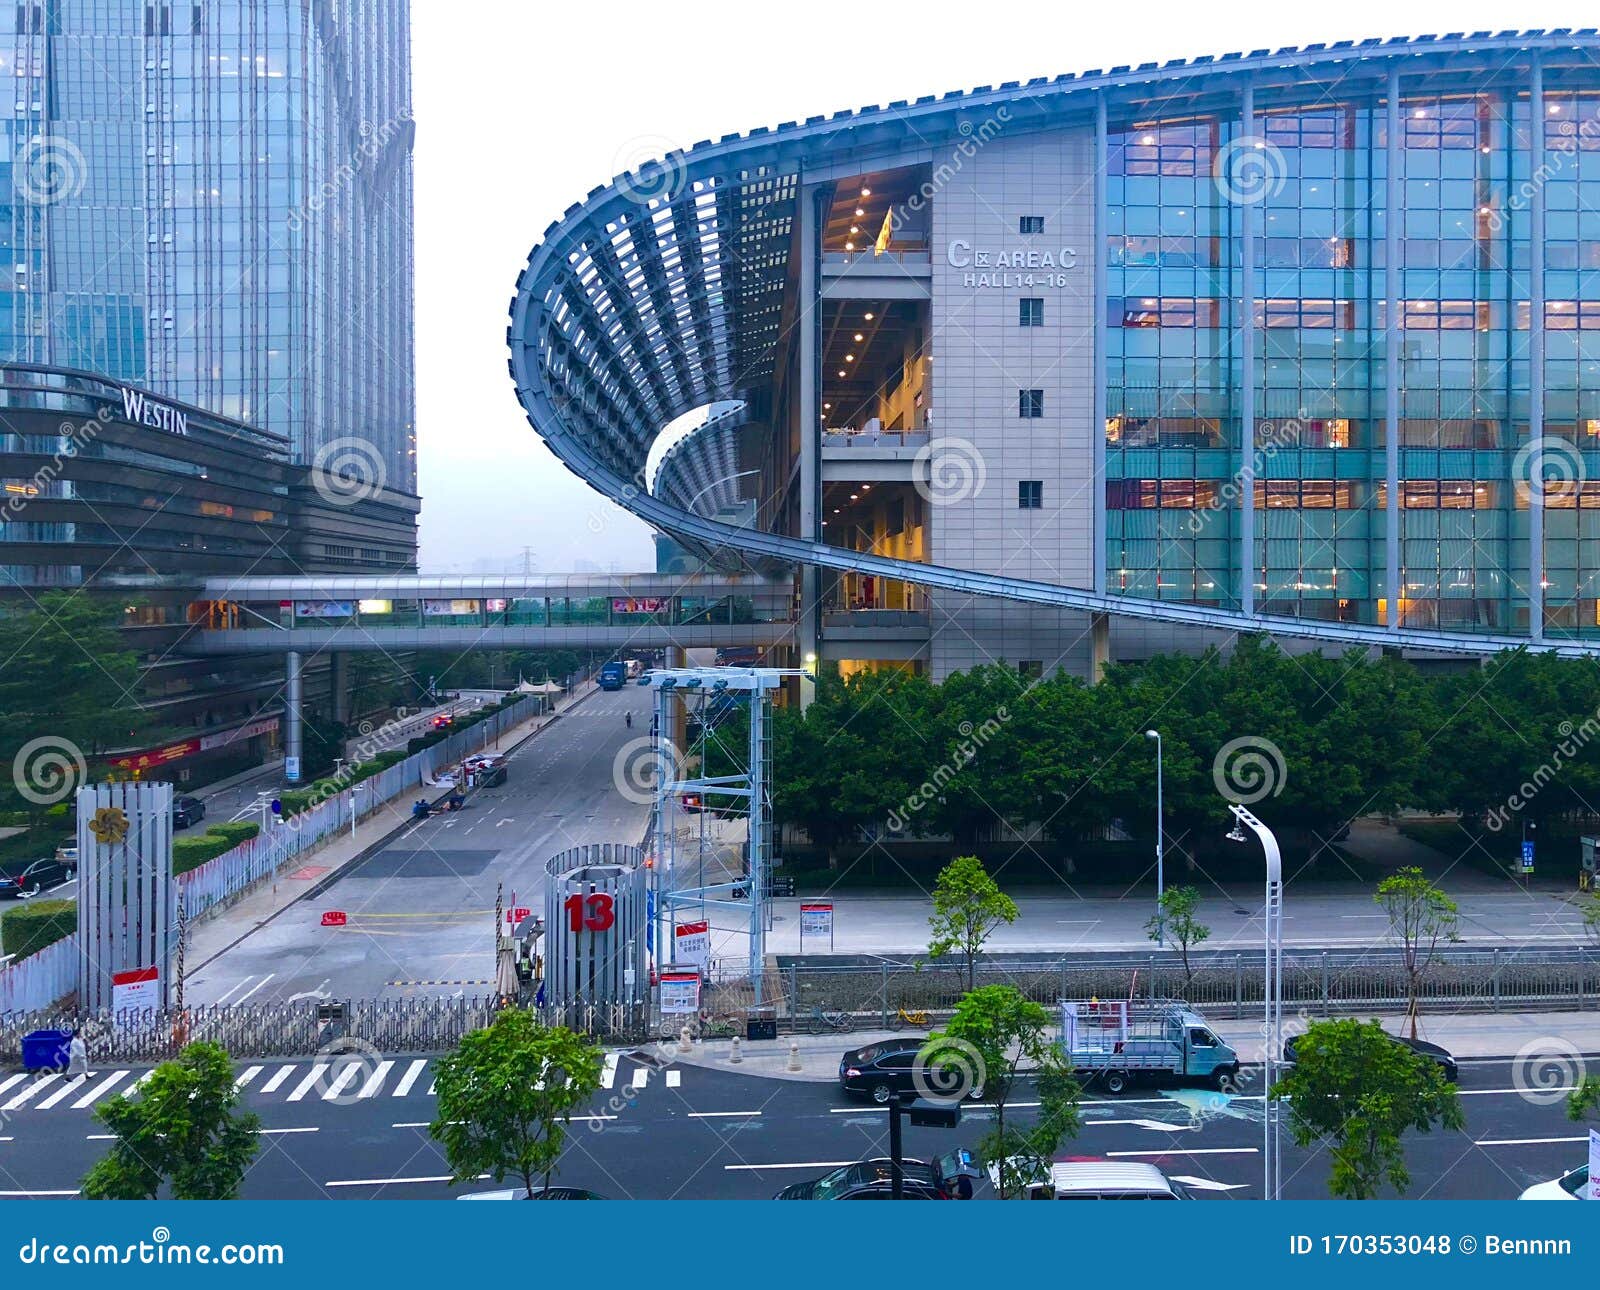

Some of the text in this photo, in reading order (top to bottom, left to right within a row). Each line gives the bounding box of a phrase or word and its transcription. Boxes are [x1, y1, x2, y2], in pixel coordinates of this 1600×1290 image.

[995, 250, 1056, 268] AREA
[1059, 248, 1077, 269] C
[963, 273, 1067, 288] HALL 14-16
[564, 893, 615, 932] 13
